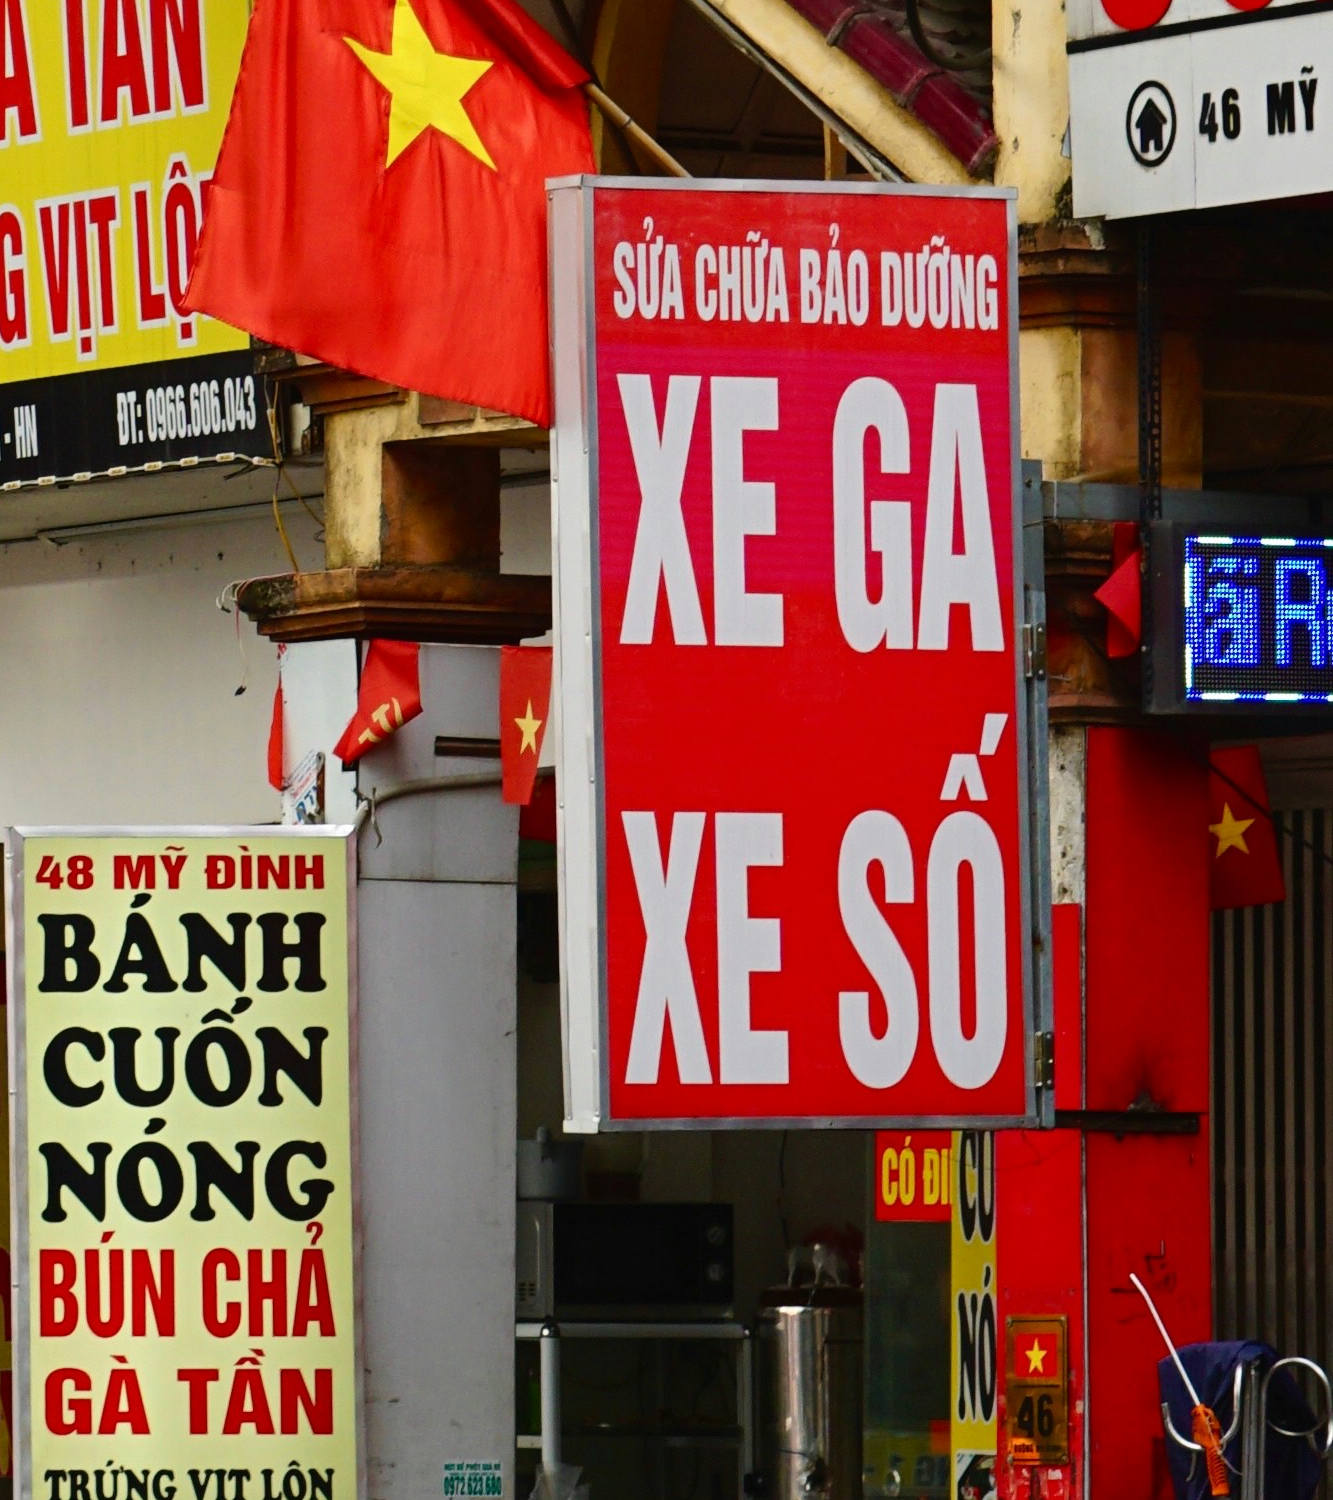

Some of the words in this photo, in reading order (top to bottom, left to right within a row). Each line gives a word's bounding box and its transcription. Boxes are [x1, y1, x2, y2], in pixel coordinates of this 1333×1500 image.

[1198, 89, 1240, 143] 46
[1265, 66, 1318, 137] MỸ
[614, 215, 684, 321] SỬA
[694, 232, 789, 325] CHỮA
[799, 221, 870, 329] BẢO
[880, 234, 998, 332] DƯỠNG
[15, 404, 38, 457] HN
[118, 390, 142, 446] ĐT:
[146, 376, 256, 440] 0966.606.043
[617, 372, 785, 648] XE
[832, 375, 1006, 654] GA
[35, 856, 94, 889] 48
[112, 846, 188, 890] MỸ
[205, 846, 325, 890] ĐÌNH
[622, 809, 789, 1087] XE
[837, 712, 1009, 1090] SỐ
[37, 893, 327, 994] BÁNH
[43, 998, 329, 1108] CUỐN
[39, 1117, 335, 1224] NÓNG
[881, 1136, 916, 1207] CÓ
[40, 1231, 176, 1338] BÚN
[203, 1221, 336, 1339] CHẢ
[44, 1355, 151, 1436] GÀ
[1017, 1394, 1054, 1438] 46
